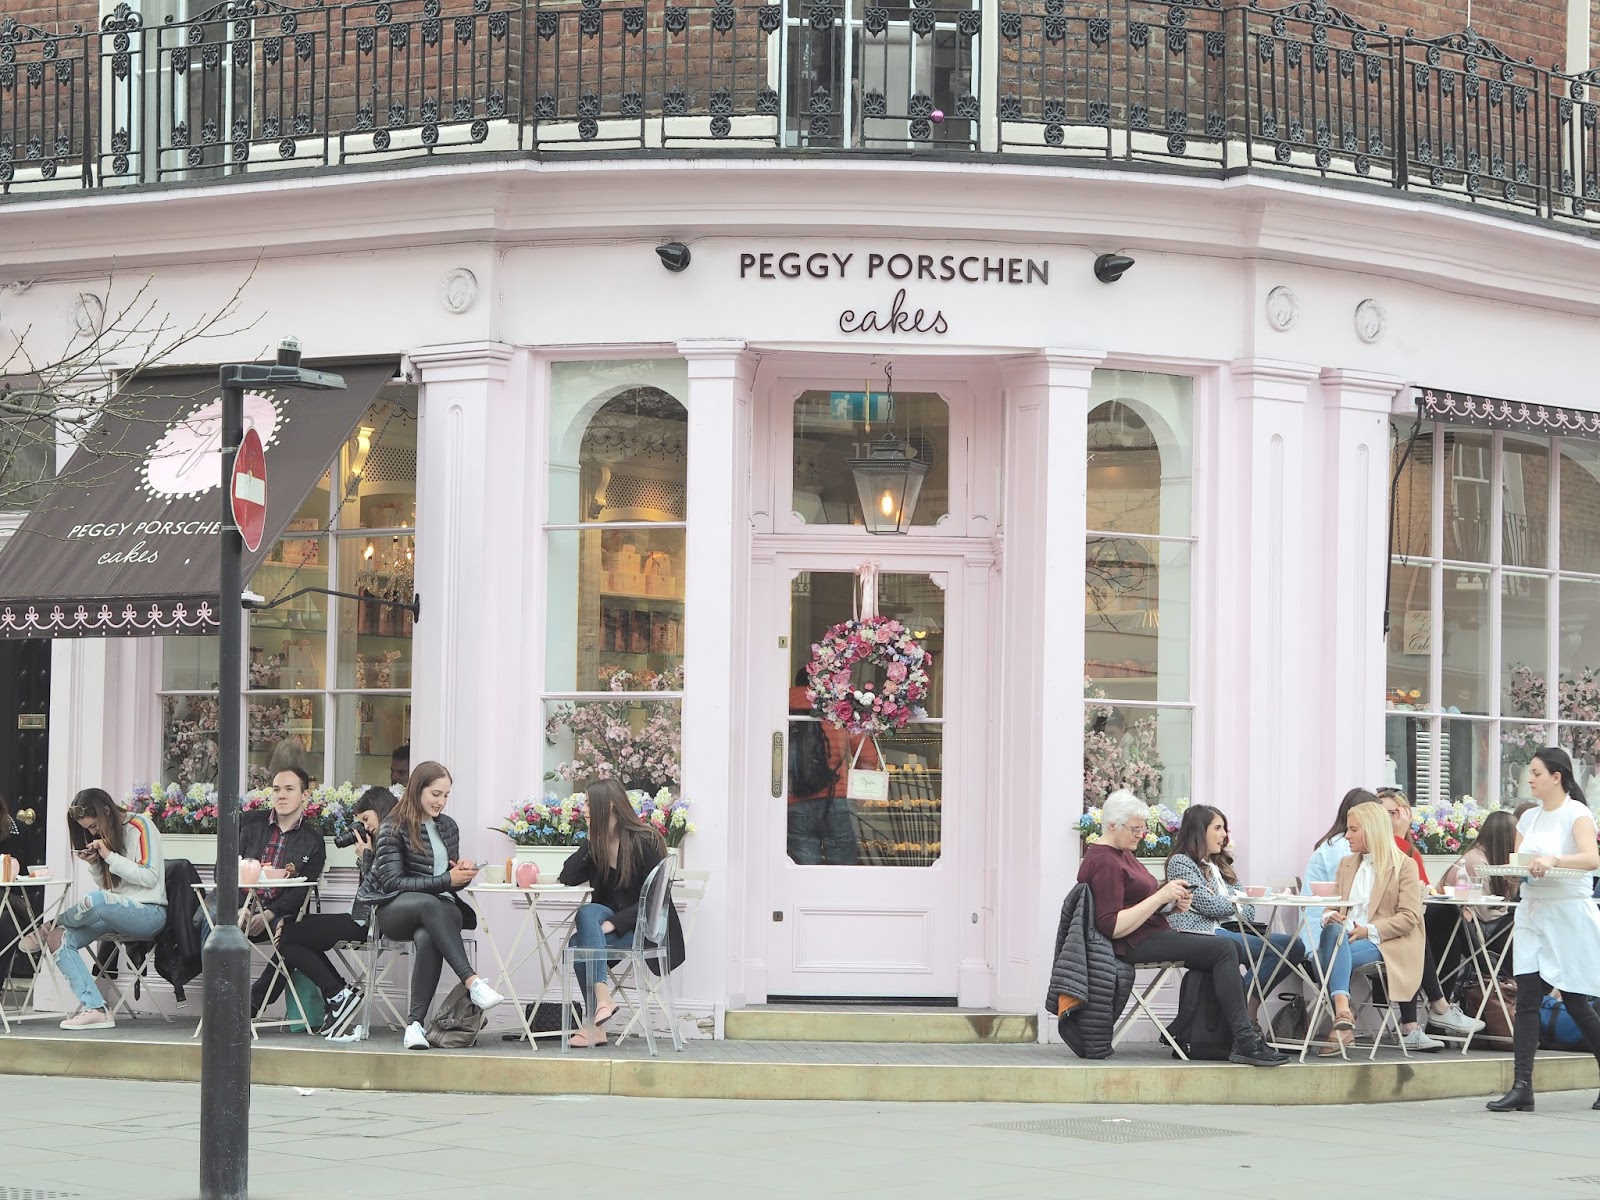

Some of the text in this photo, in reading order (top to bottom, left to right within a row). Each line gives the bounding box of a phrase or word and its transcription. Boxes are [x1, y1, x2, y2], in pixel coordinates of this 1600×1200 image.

[740, 252, 1049, 285] PEGGY PORSCHEN
[839, 288, 948, 334] cakes
[67, 520, 222, 538] PEGGY PORSCHE
[97, 540, 158, 565] cakes
